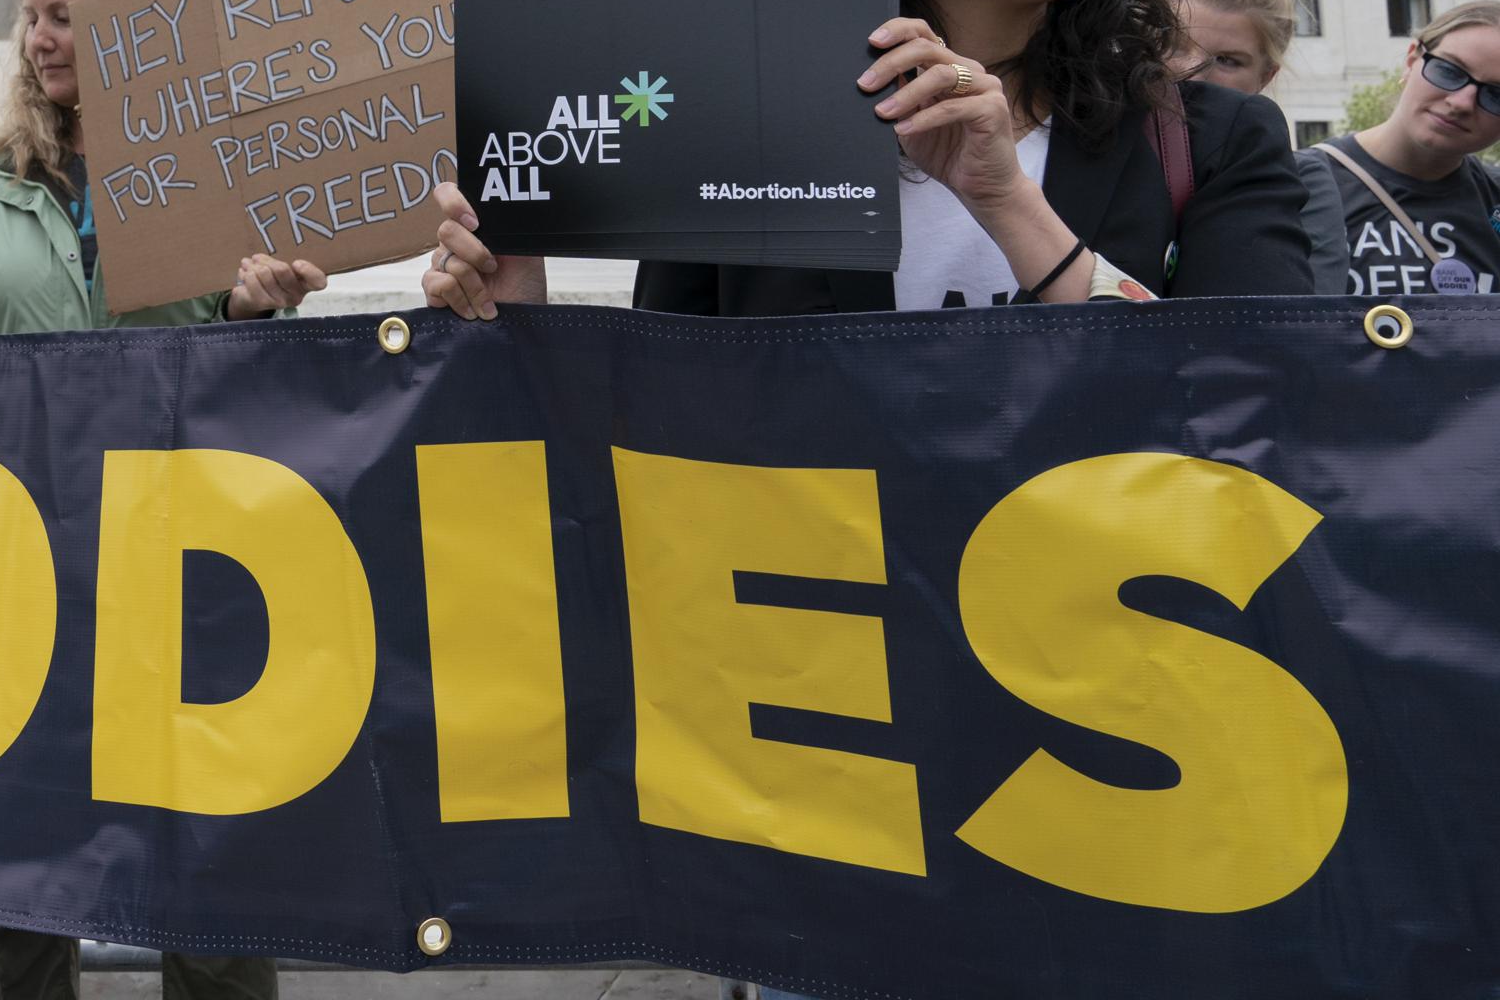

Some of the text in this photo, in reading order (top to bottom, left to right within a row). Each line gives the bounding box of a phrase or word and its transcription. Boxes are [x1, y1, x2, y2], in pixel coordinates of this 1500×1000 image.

[123, 39, 337, 144] WHERE'S
[547, 95, 620, 130] ALL
[102, 84, 445, 223] FOR PERSONAL
[479, 129, 620, 167] ABOVE
[481, 167, 550, 202] ALL
[700, 182, 876, 200] #AbortionJustice
[1346, 220, 1456, 259] ANS
